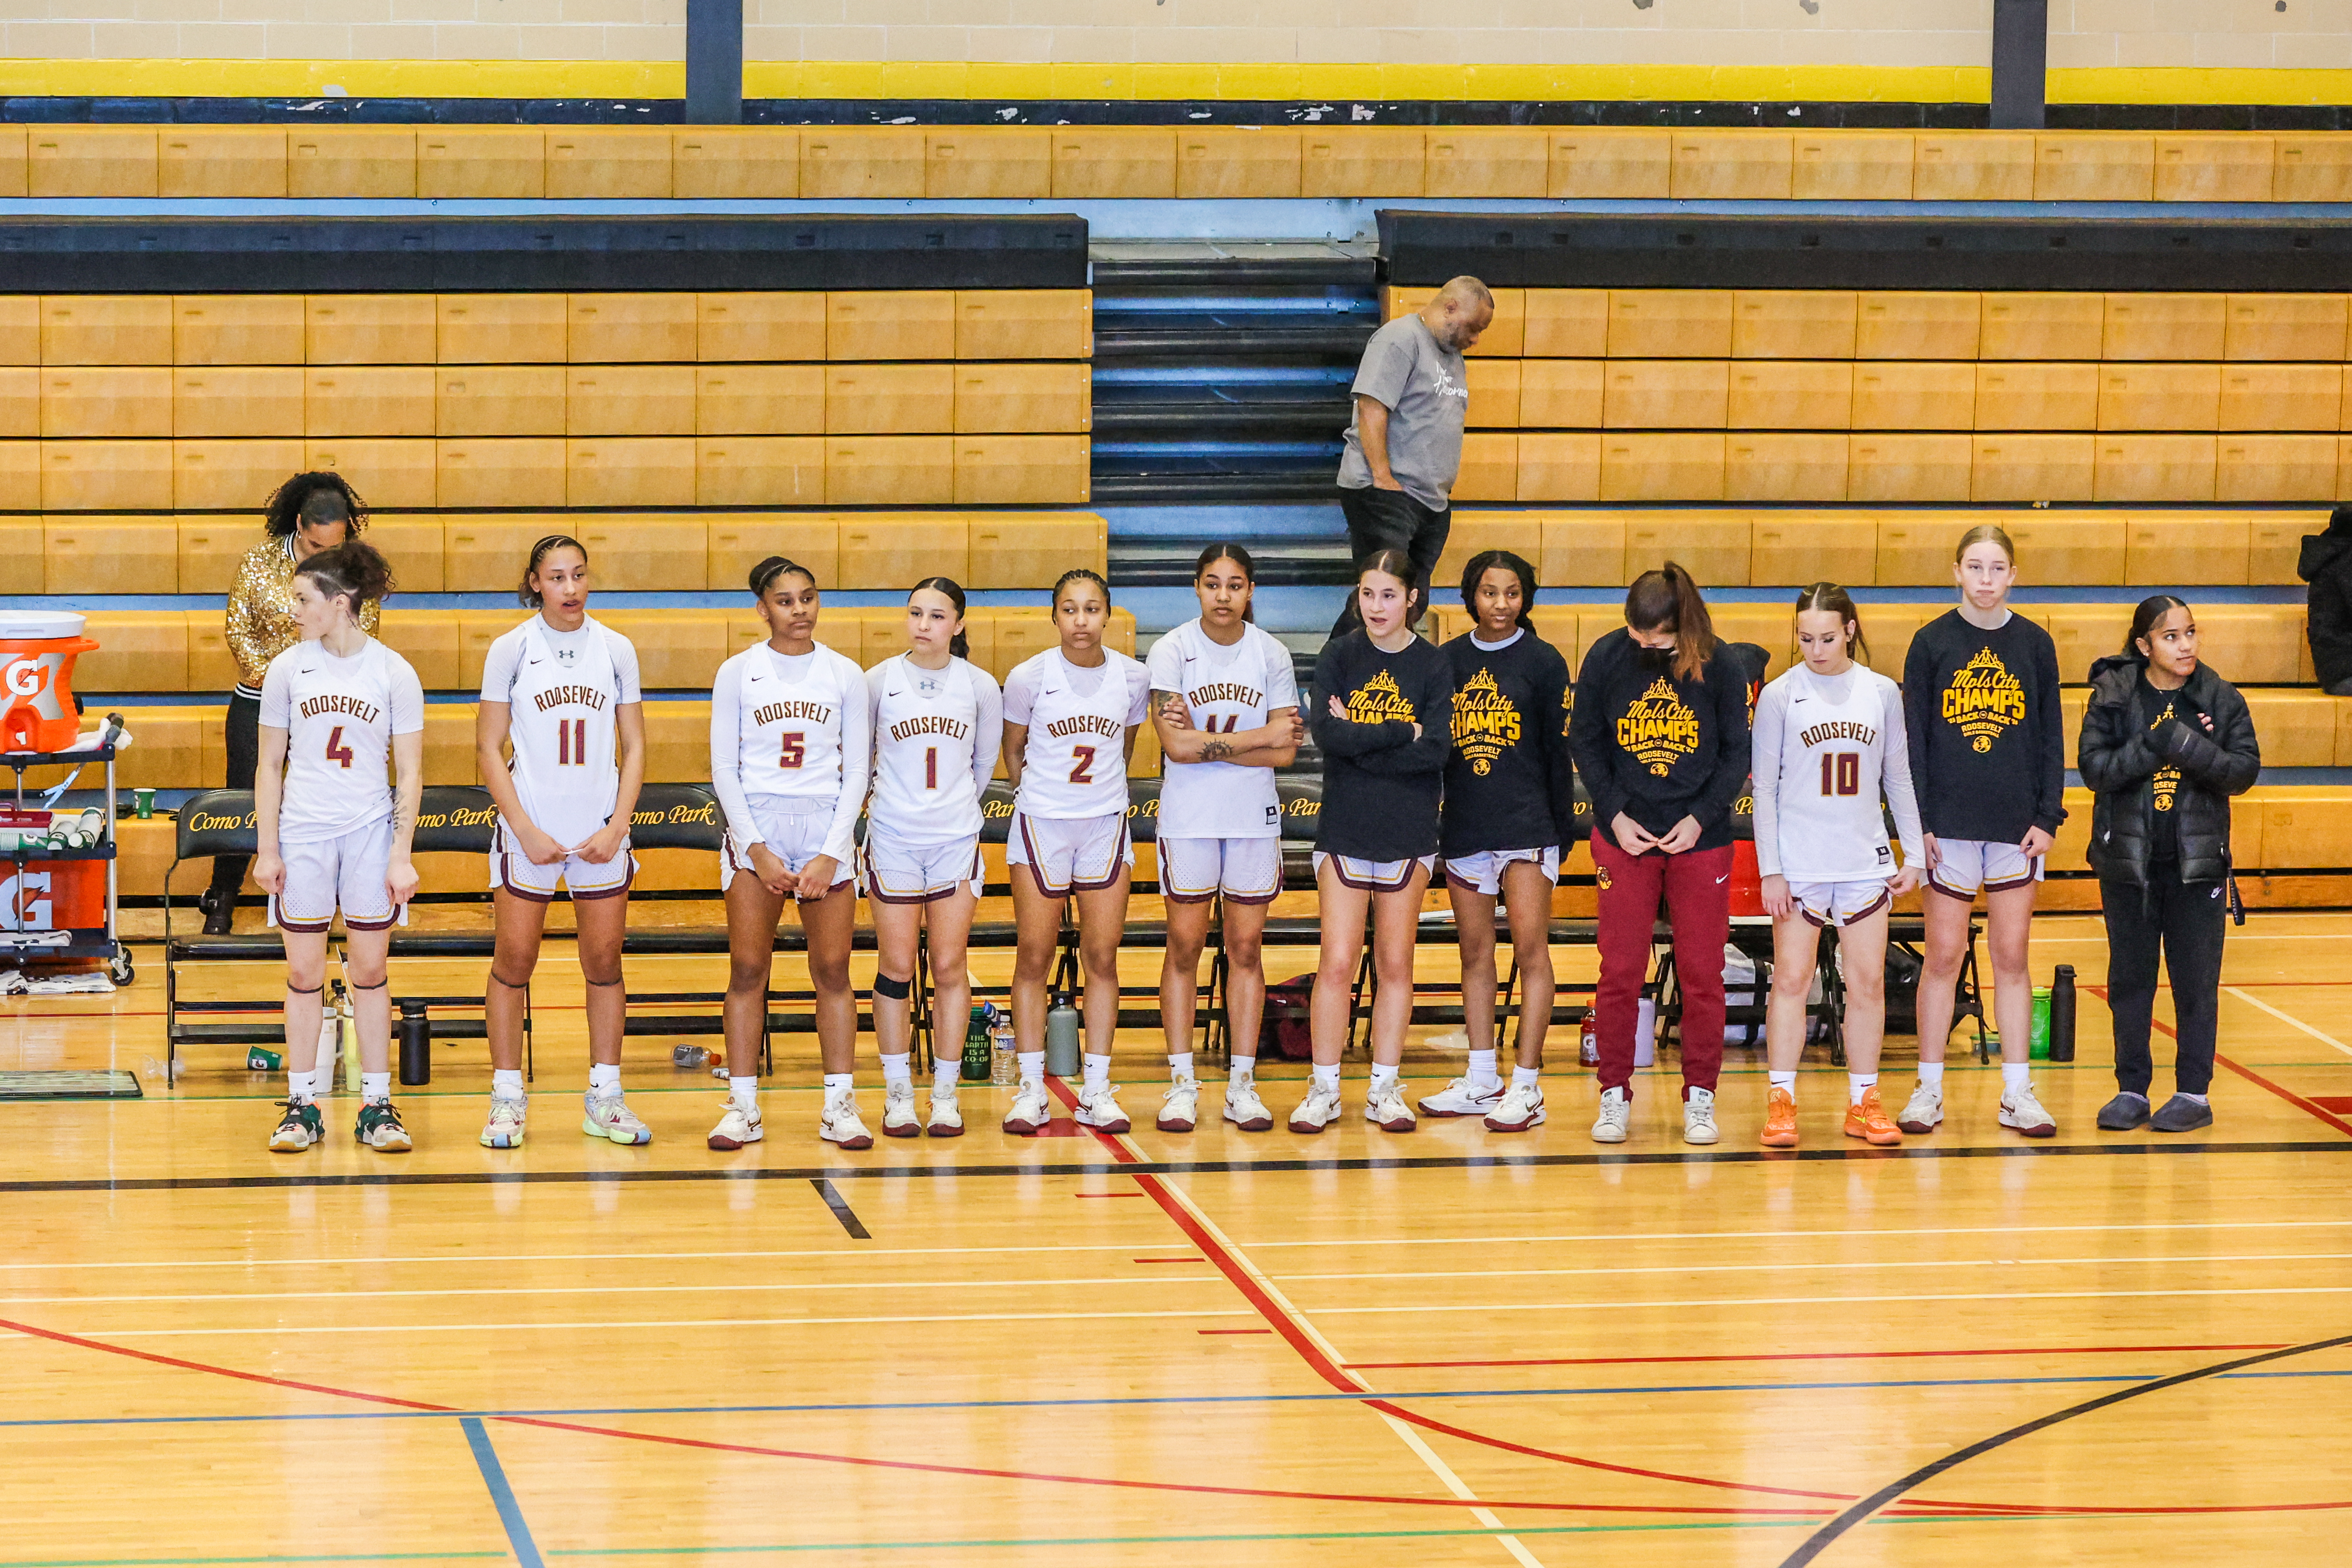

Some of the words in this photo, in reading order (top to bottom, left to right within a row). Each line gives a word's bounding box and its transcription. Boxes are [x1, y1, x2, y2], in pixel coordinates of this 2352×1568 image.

[5, 659, 39, 696] G
[1952, 669, 1992, 693] Mpls
[1992, 670, 2021, 697] City
[534, 685, 606, 712] ROOSEVELT
[1188, 683, 1263, 708] ROOSEVELT
[1348, 690, 1385, 715] Mpls
[1385, 693, 1414, 720] City
[1486, 691, 1514, 718] City
[1942, 689, 2026, 719] CHAMPS
[300, 695, 380, 724] ROOSEVELT
[754, 701, 831, 726] ROOSEVELT
[1627, 700, 1666, 724] Mpls
[1666, 702, 1695, 727] City
[1956, 712, 1979, 723] BACK
[1987, 712, 2011, 725] BACK
[890, 716, 968, 742] ROOSEVELT
[1047, 715, 1121, 739] ROOSEVELT
[1484, 735, 1507, 746] BACK
[1617, 718, 1699, 748] CHAMPS
[1800, 722, 1876, 748] ROOSEVELT
[1961, 722, 2004, 733] ROOSEVELT
[326, 725, 354, 769] 4
[558, 718, 586, 766] 11
[778, 731, 807, 769] 5
[1462, 745, 1502, 756] ROOSEVELT
[1631, 740, 1655, 752] BACK
[1663, 741, 1686, 753] BACK
[1637, 751, 1679, 760] ROOSEVELT
[924, 746, 937, 790] 1
[1068, 744, 1097, 785] 2
[1820, 752, 1860, 797] 10
[189, 812, 241, 832] Como
[450, 804, 497, 828] Park
[668, 801, 716, 825] Park
